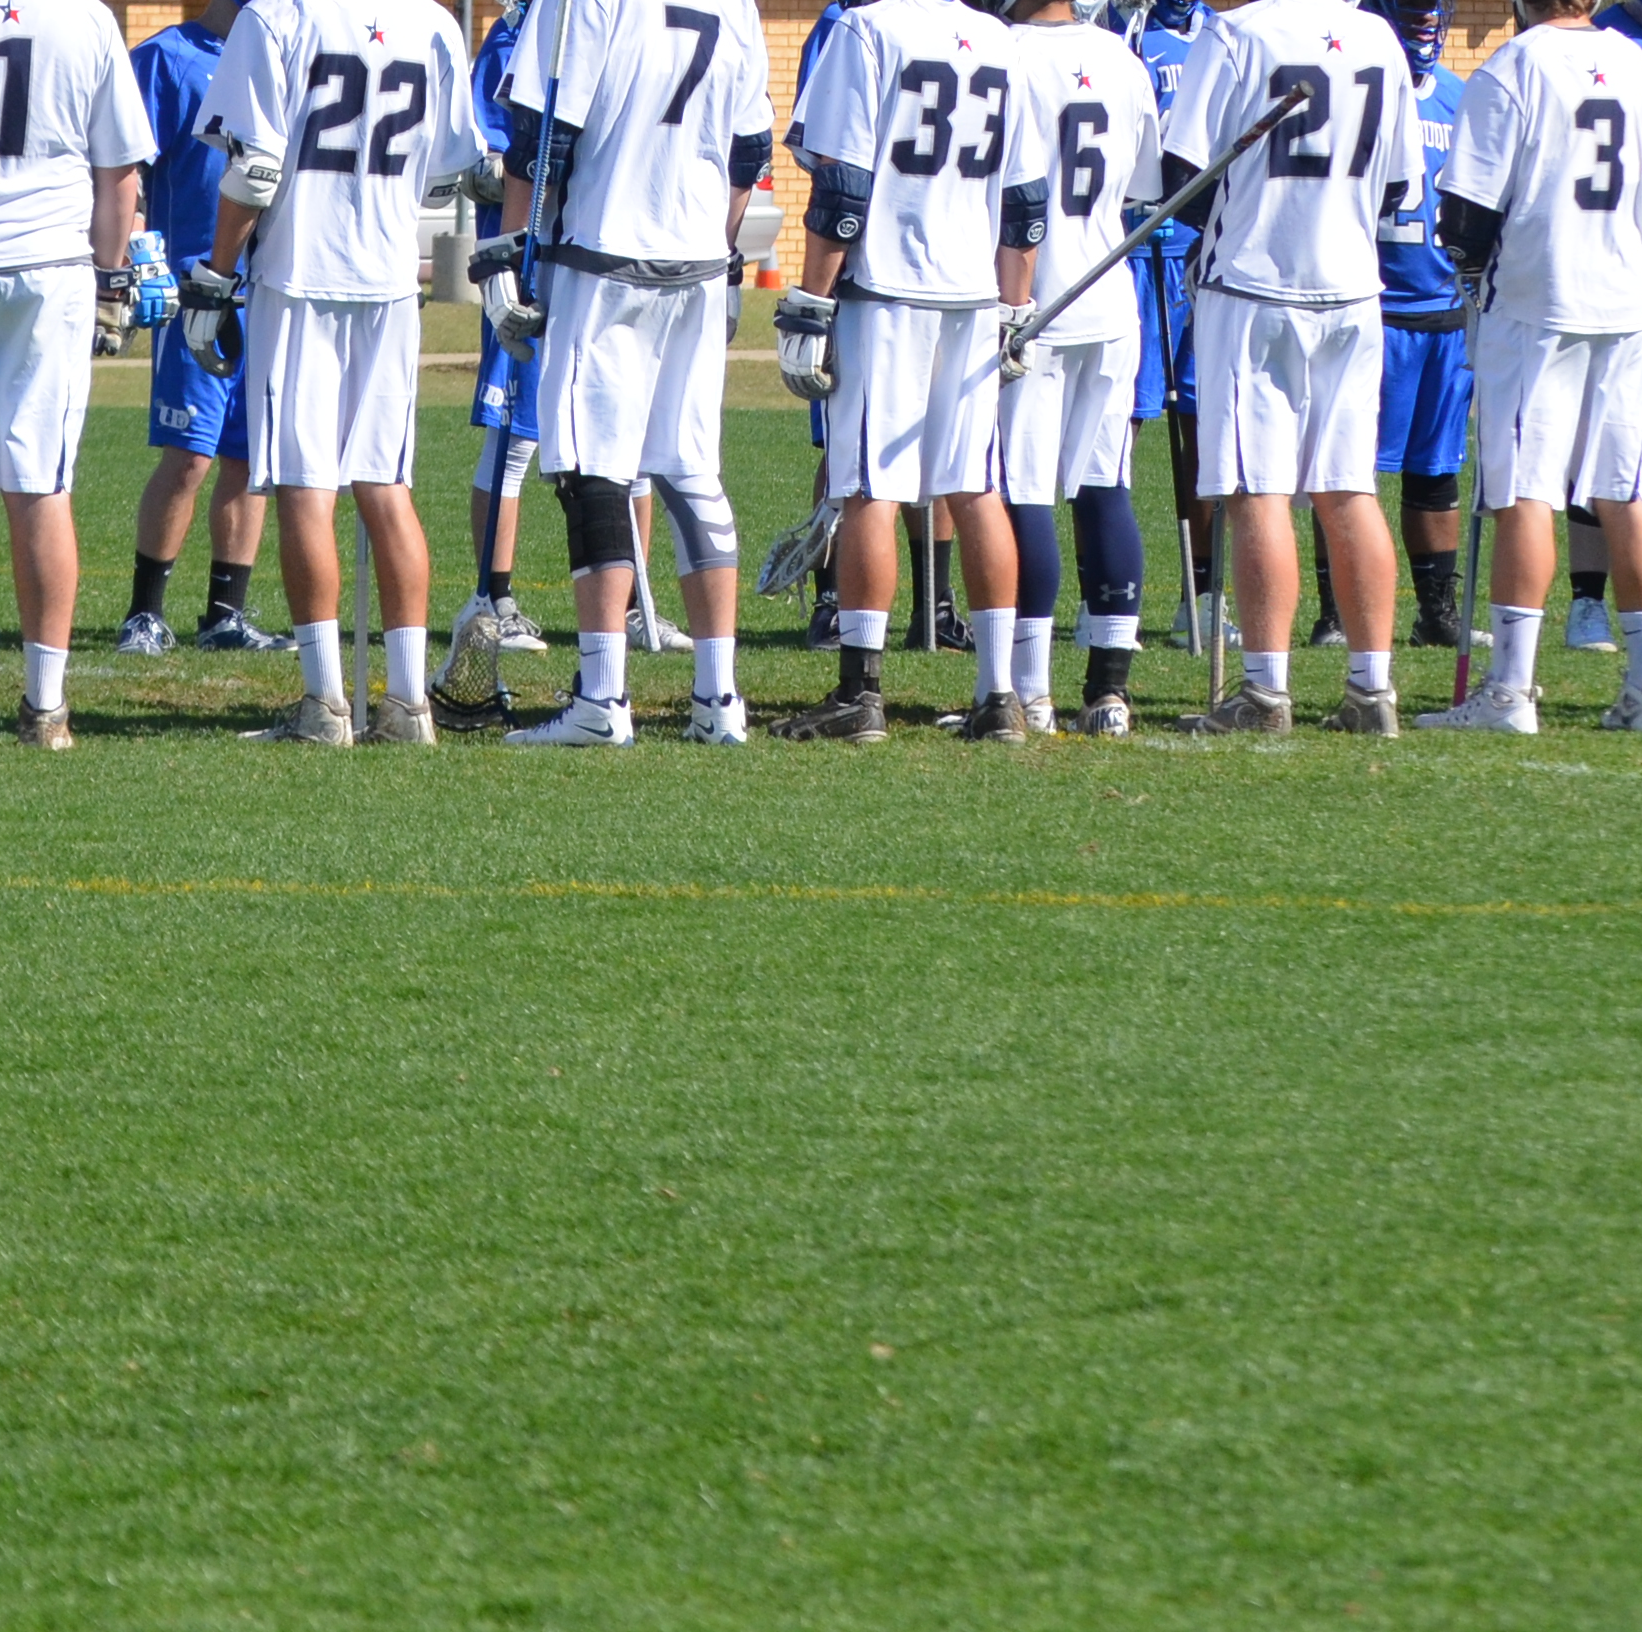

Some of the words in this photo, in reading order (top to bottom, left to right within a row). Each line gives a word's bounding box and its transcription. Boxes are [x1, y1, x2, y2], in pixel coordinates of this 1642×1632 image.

[296, 51, 428, 177] 22
[657, 3, 721, 126] 7
[889, 58, 1009, 179] 33
[1268, 63, 1386, 180] 21
[249, 166, 278, 182] STX
[1057, 100, 1110, 217] 6
[1573, 98, 1626, 212] 3
